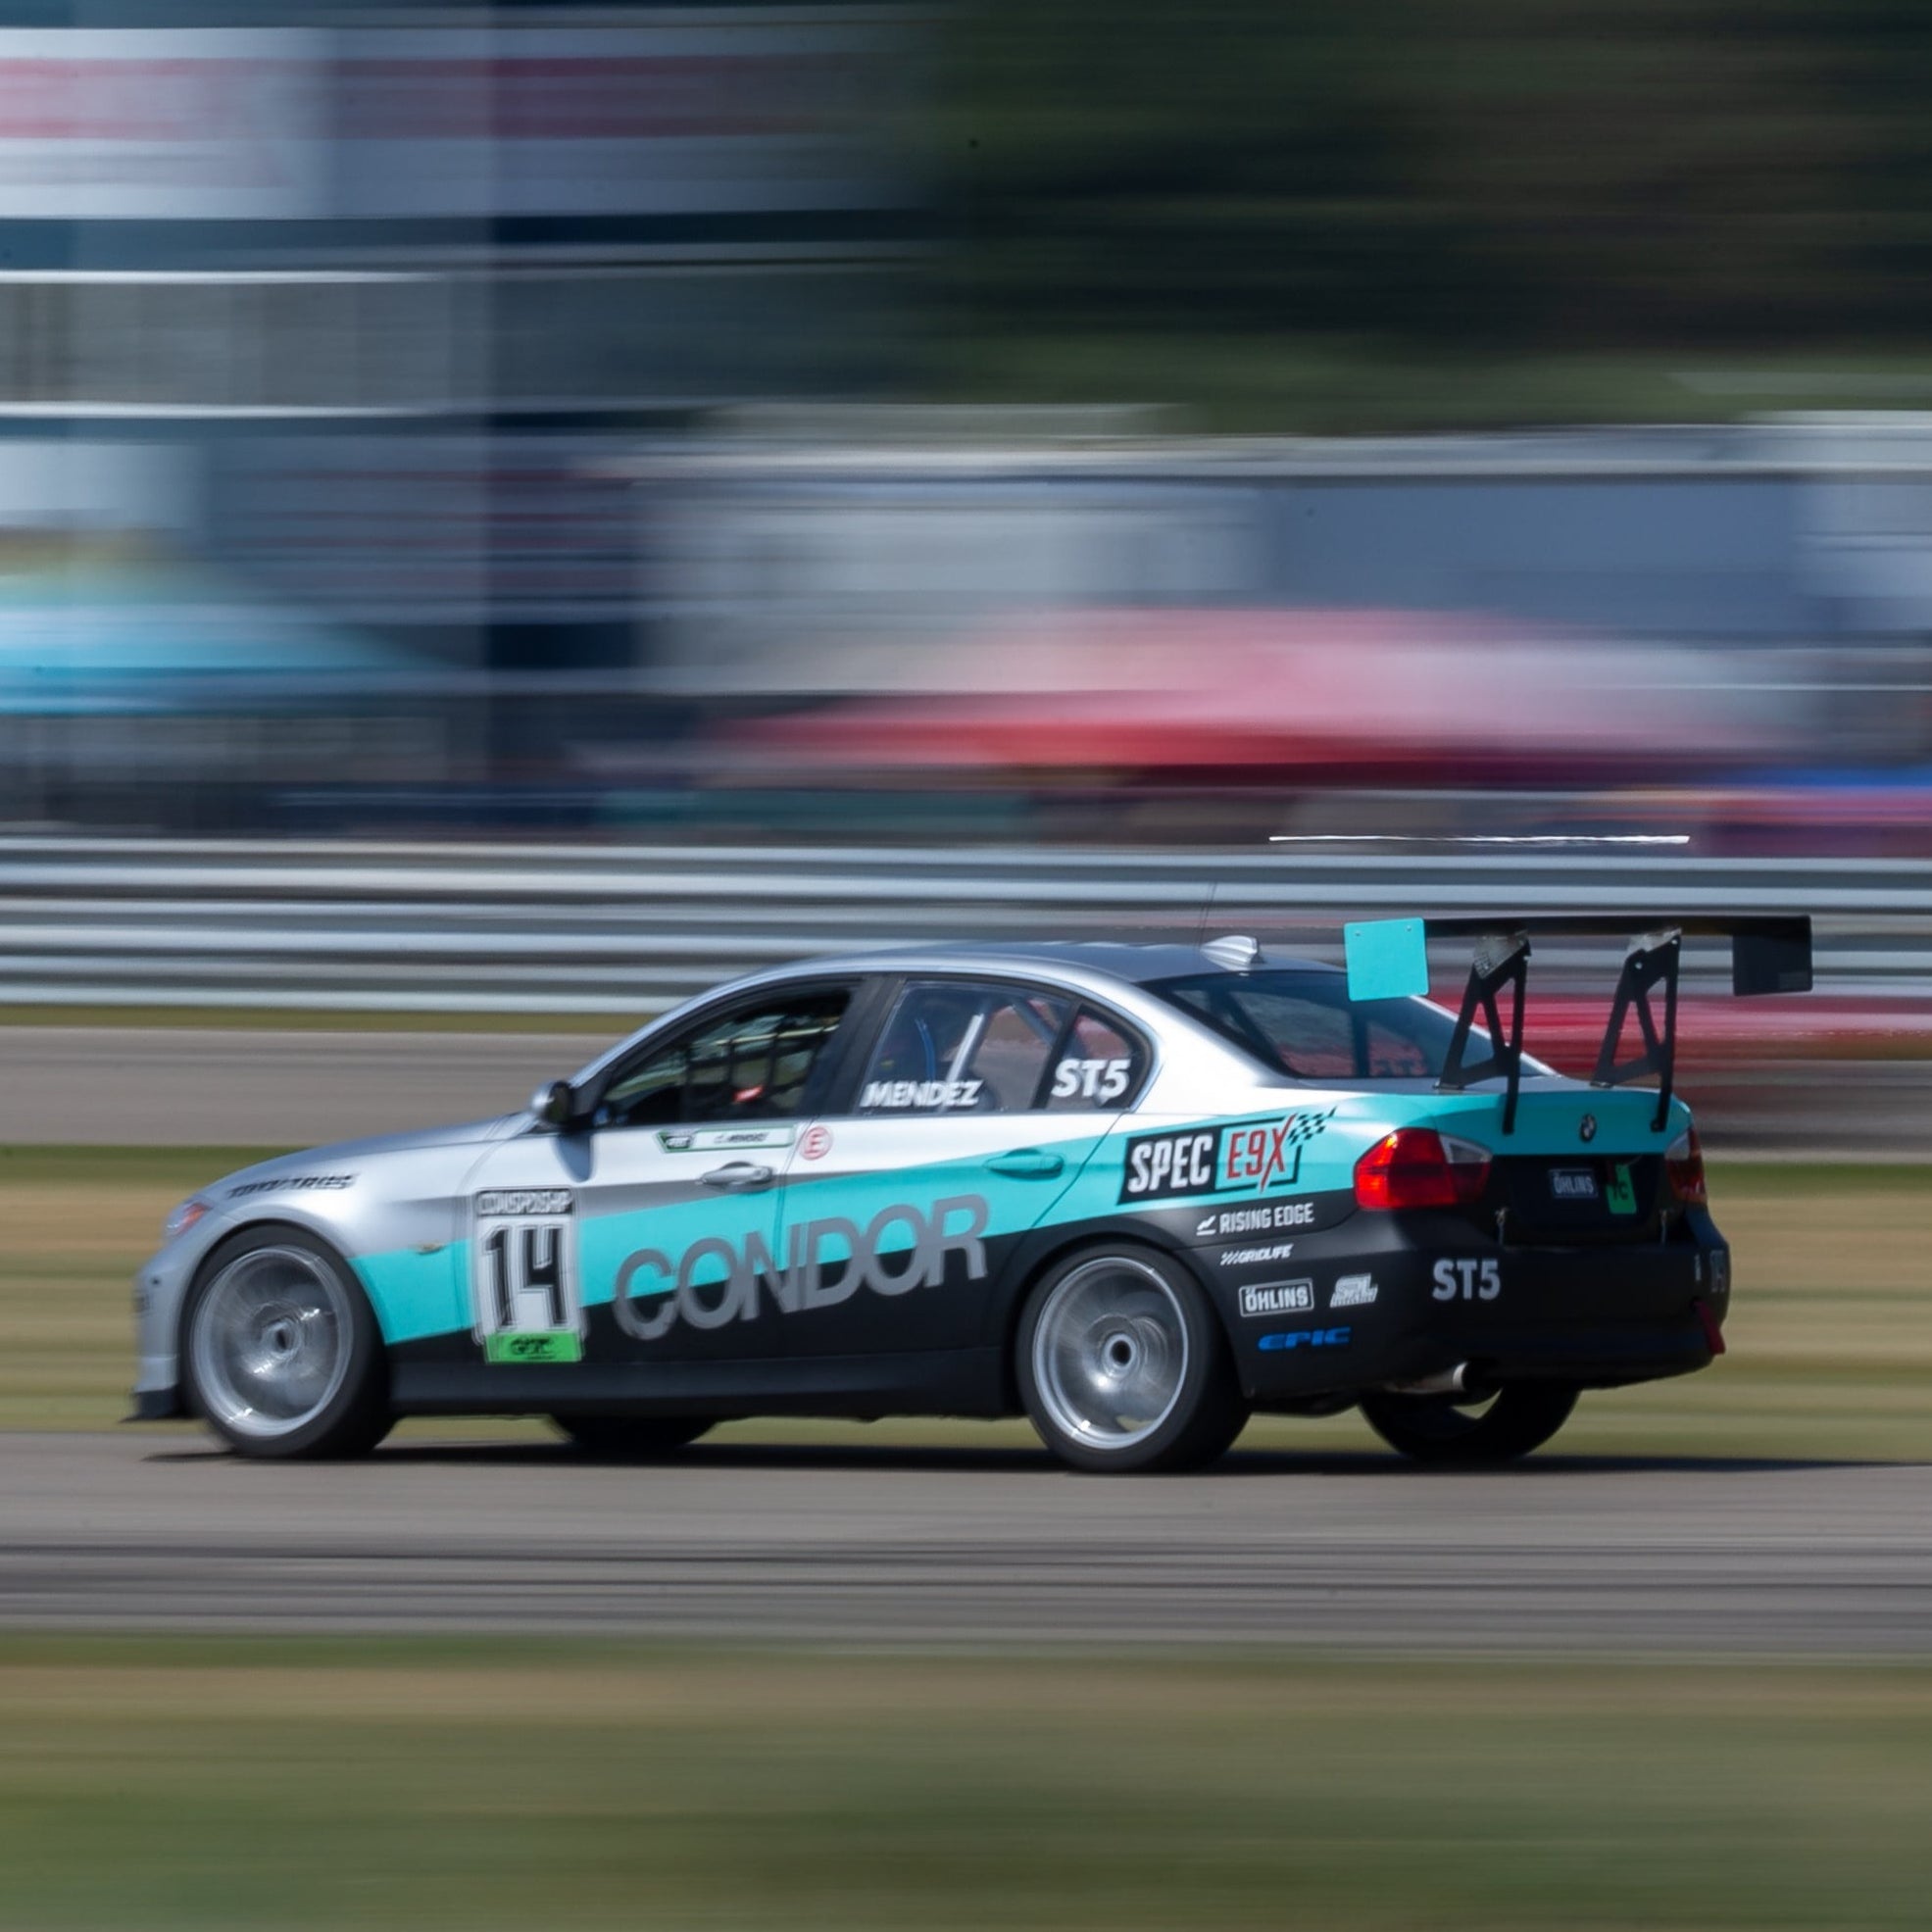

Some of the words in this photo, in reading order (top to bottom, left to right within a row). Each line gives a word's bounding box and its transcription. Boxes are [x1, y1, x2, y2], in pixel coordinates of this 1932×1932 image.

[859, 1079, 983, 1108] MENDEZ
[1051, 1059, 1131, 1098] ST5
[1127, 1132, 1214, 1193] SPEC
[1225, 1113, 1299, 1193] E9X
[1219, 1208, 1271, 1234] RISING
[1274, 1203, 1314, 1226] EDGE
[484, 1226, 569, 1327] 14
[613, 1193, 989, 1341] CONDOR
[1432, 1259, 1501, 1300] ST5
[1245, 1285, 1309, 1313] ÖHLINS
